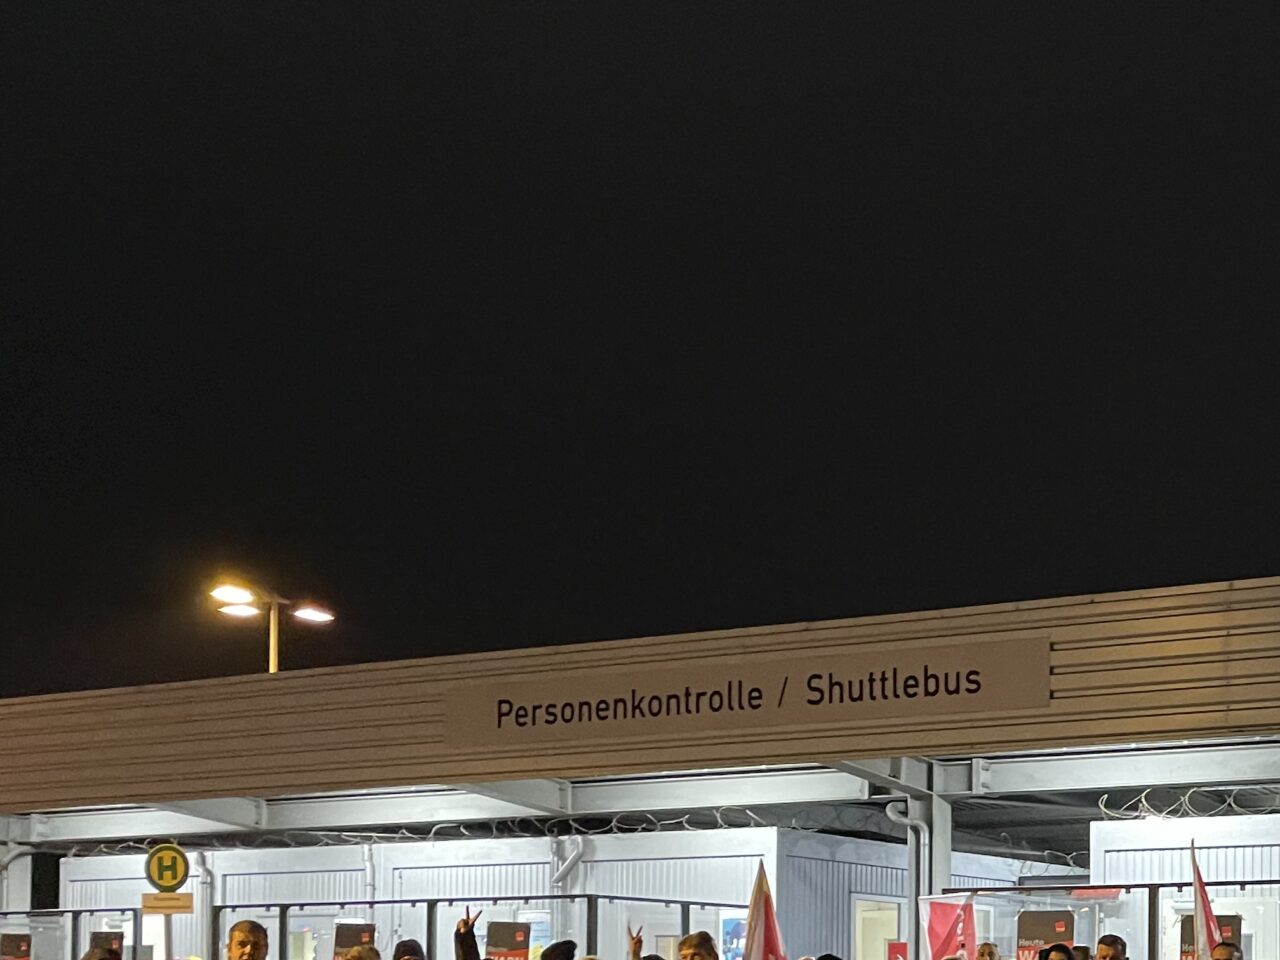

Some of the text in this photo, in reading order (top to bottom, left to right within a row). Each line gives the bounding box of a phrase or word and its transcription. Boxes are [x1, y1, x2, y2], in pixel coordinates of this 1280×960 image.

[496, 665, 982, 729] Personenkontrolle / Shuttlebus
[157, 856, 178, 881] H
